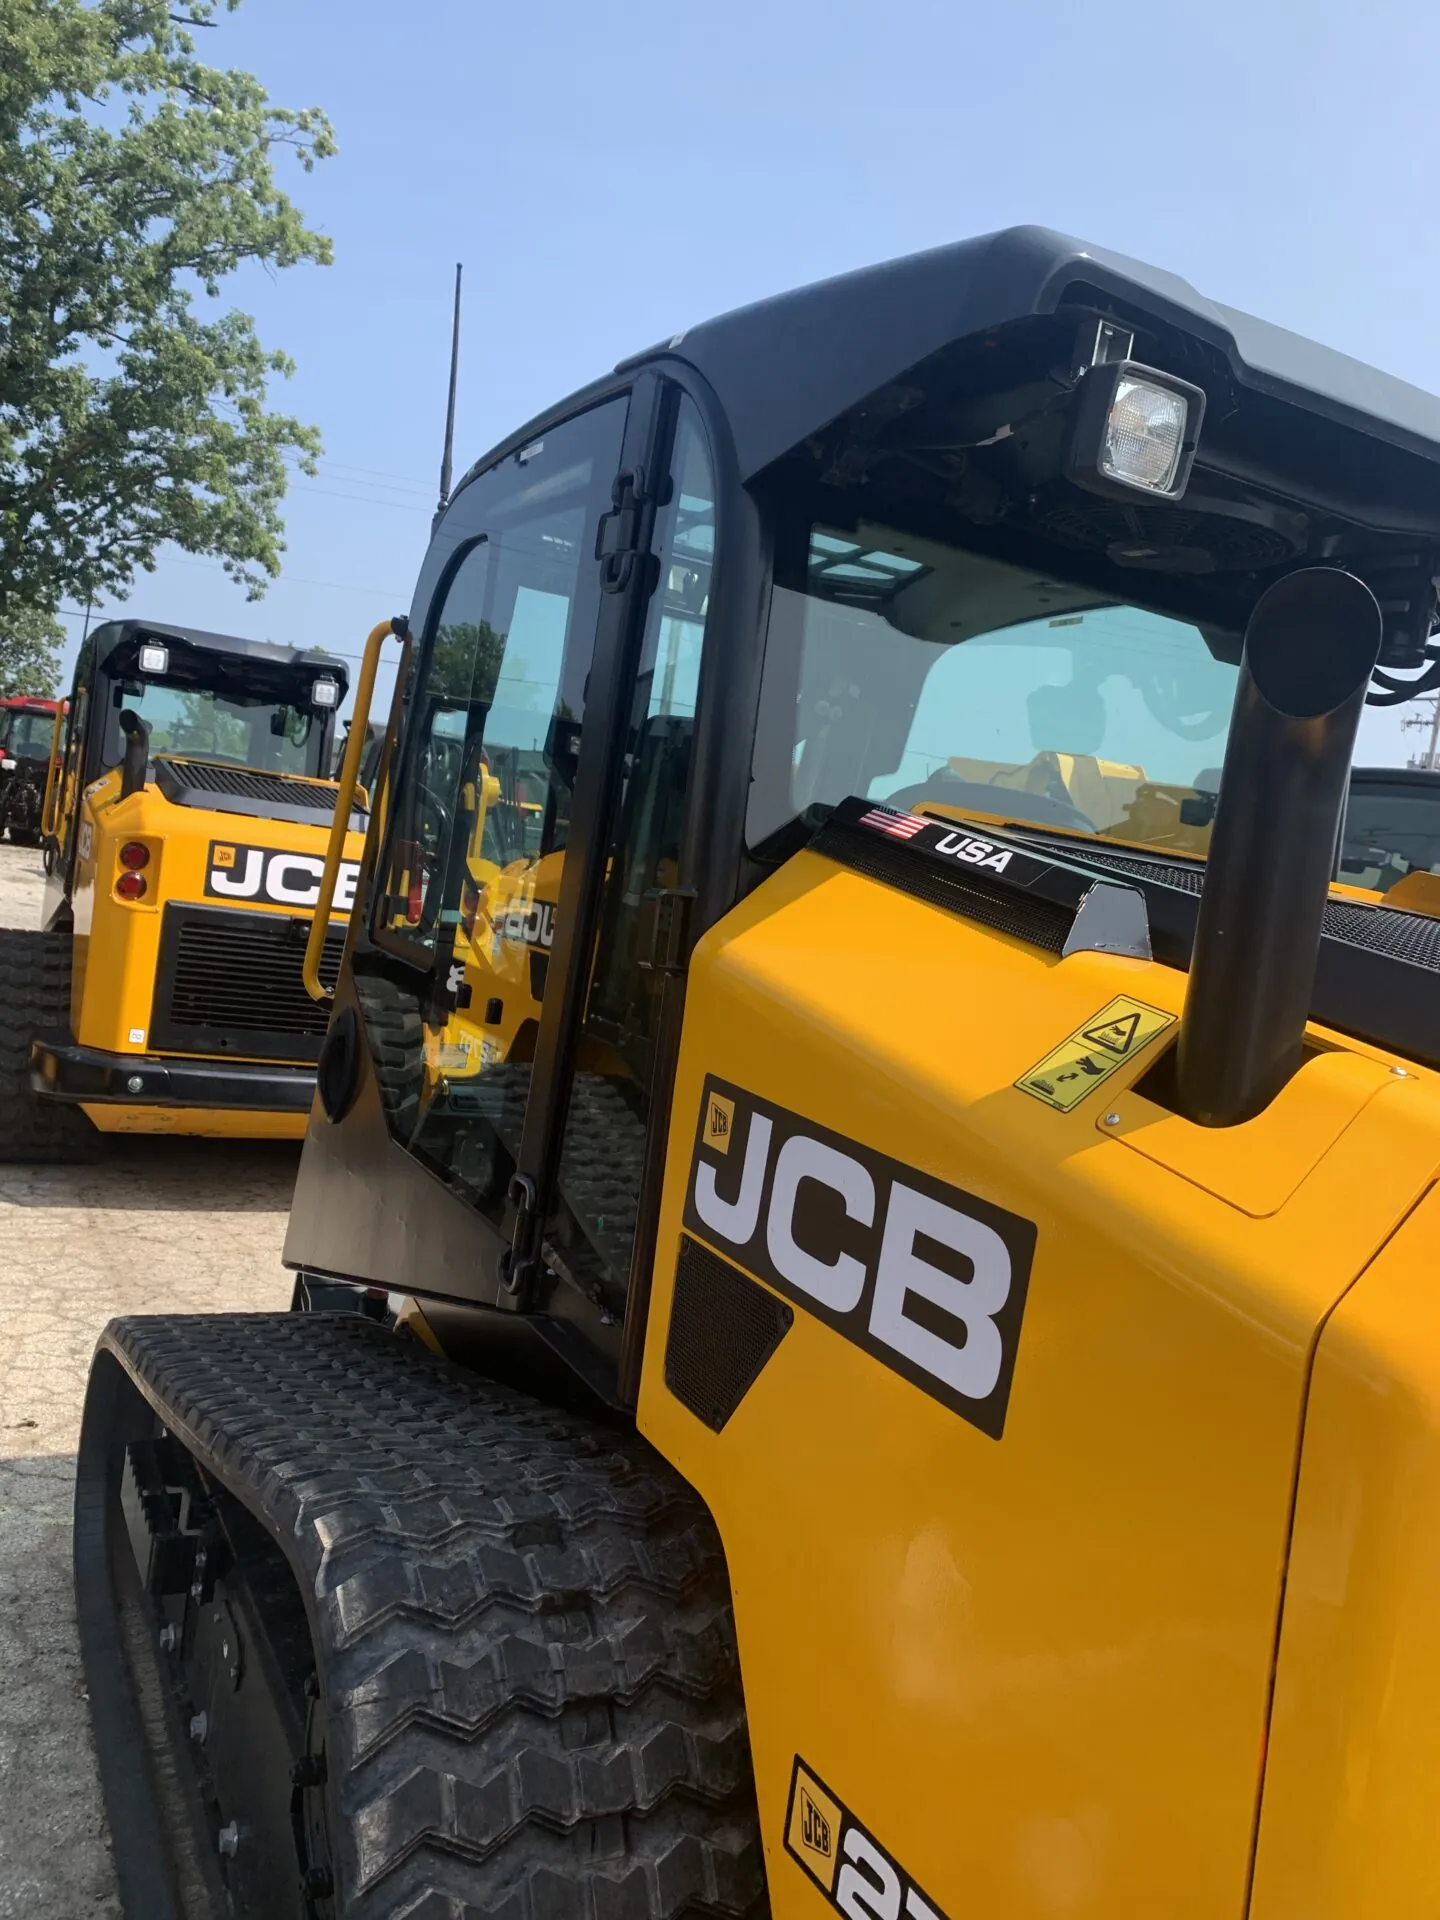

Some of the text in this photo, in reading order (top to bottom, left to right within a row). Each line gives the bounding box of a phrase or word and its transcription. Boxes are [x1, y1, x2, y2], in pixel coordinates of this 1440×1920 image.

[935, 833, 1013, 873] USA
[713, 1107, 727, 1133] JCB
[695, 1111, 1011, 1399] JCB
[804, 1799, 830, 1853] JCB
[836, 1828, 940, 1920] 2
